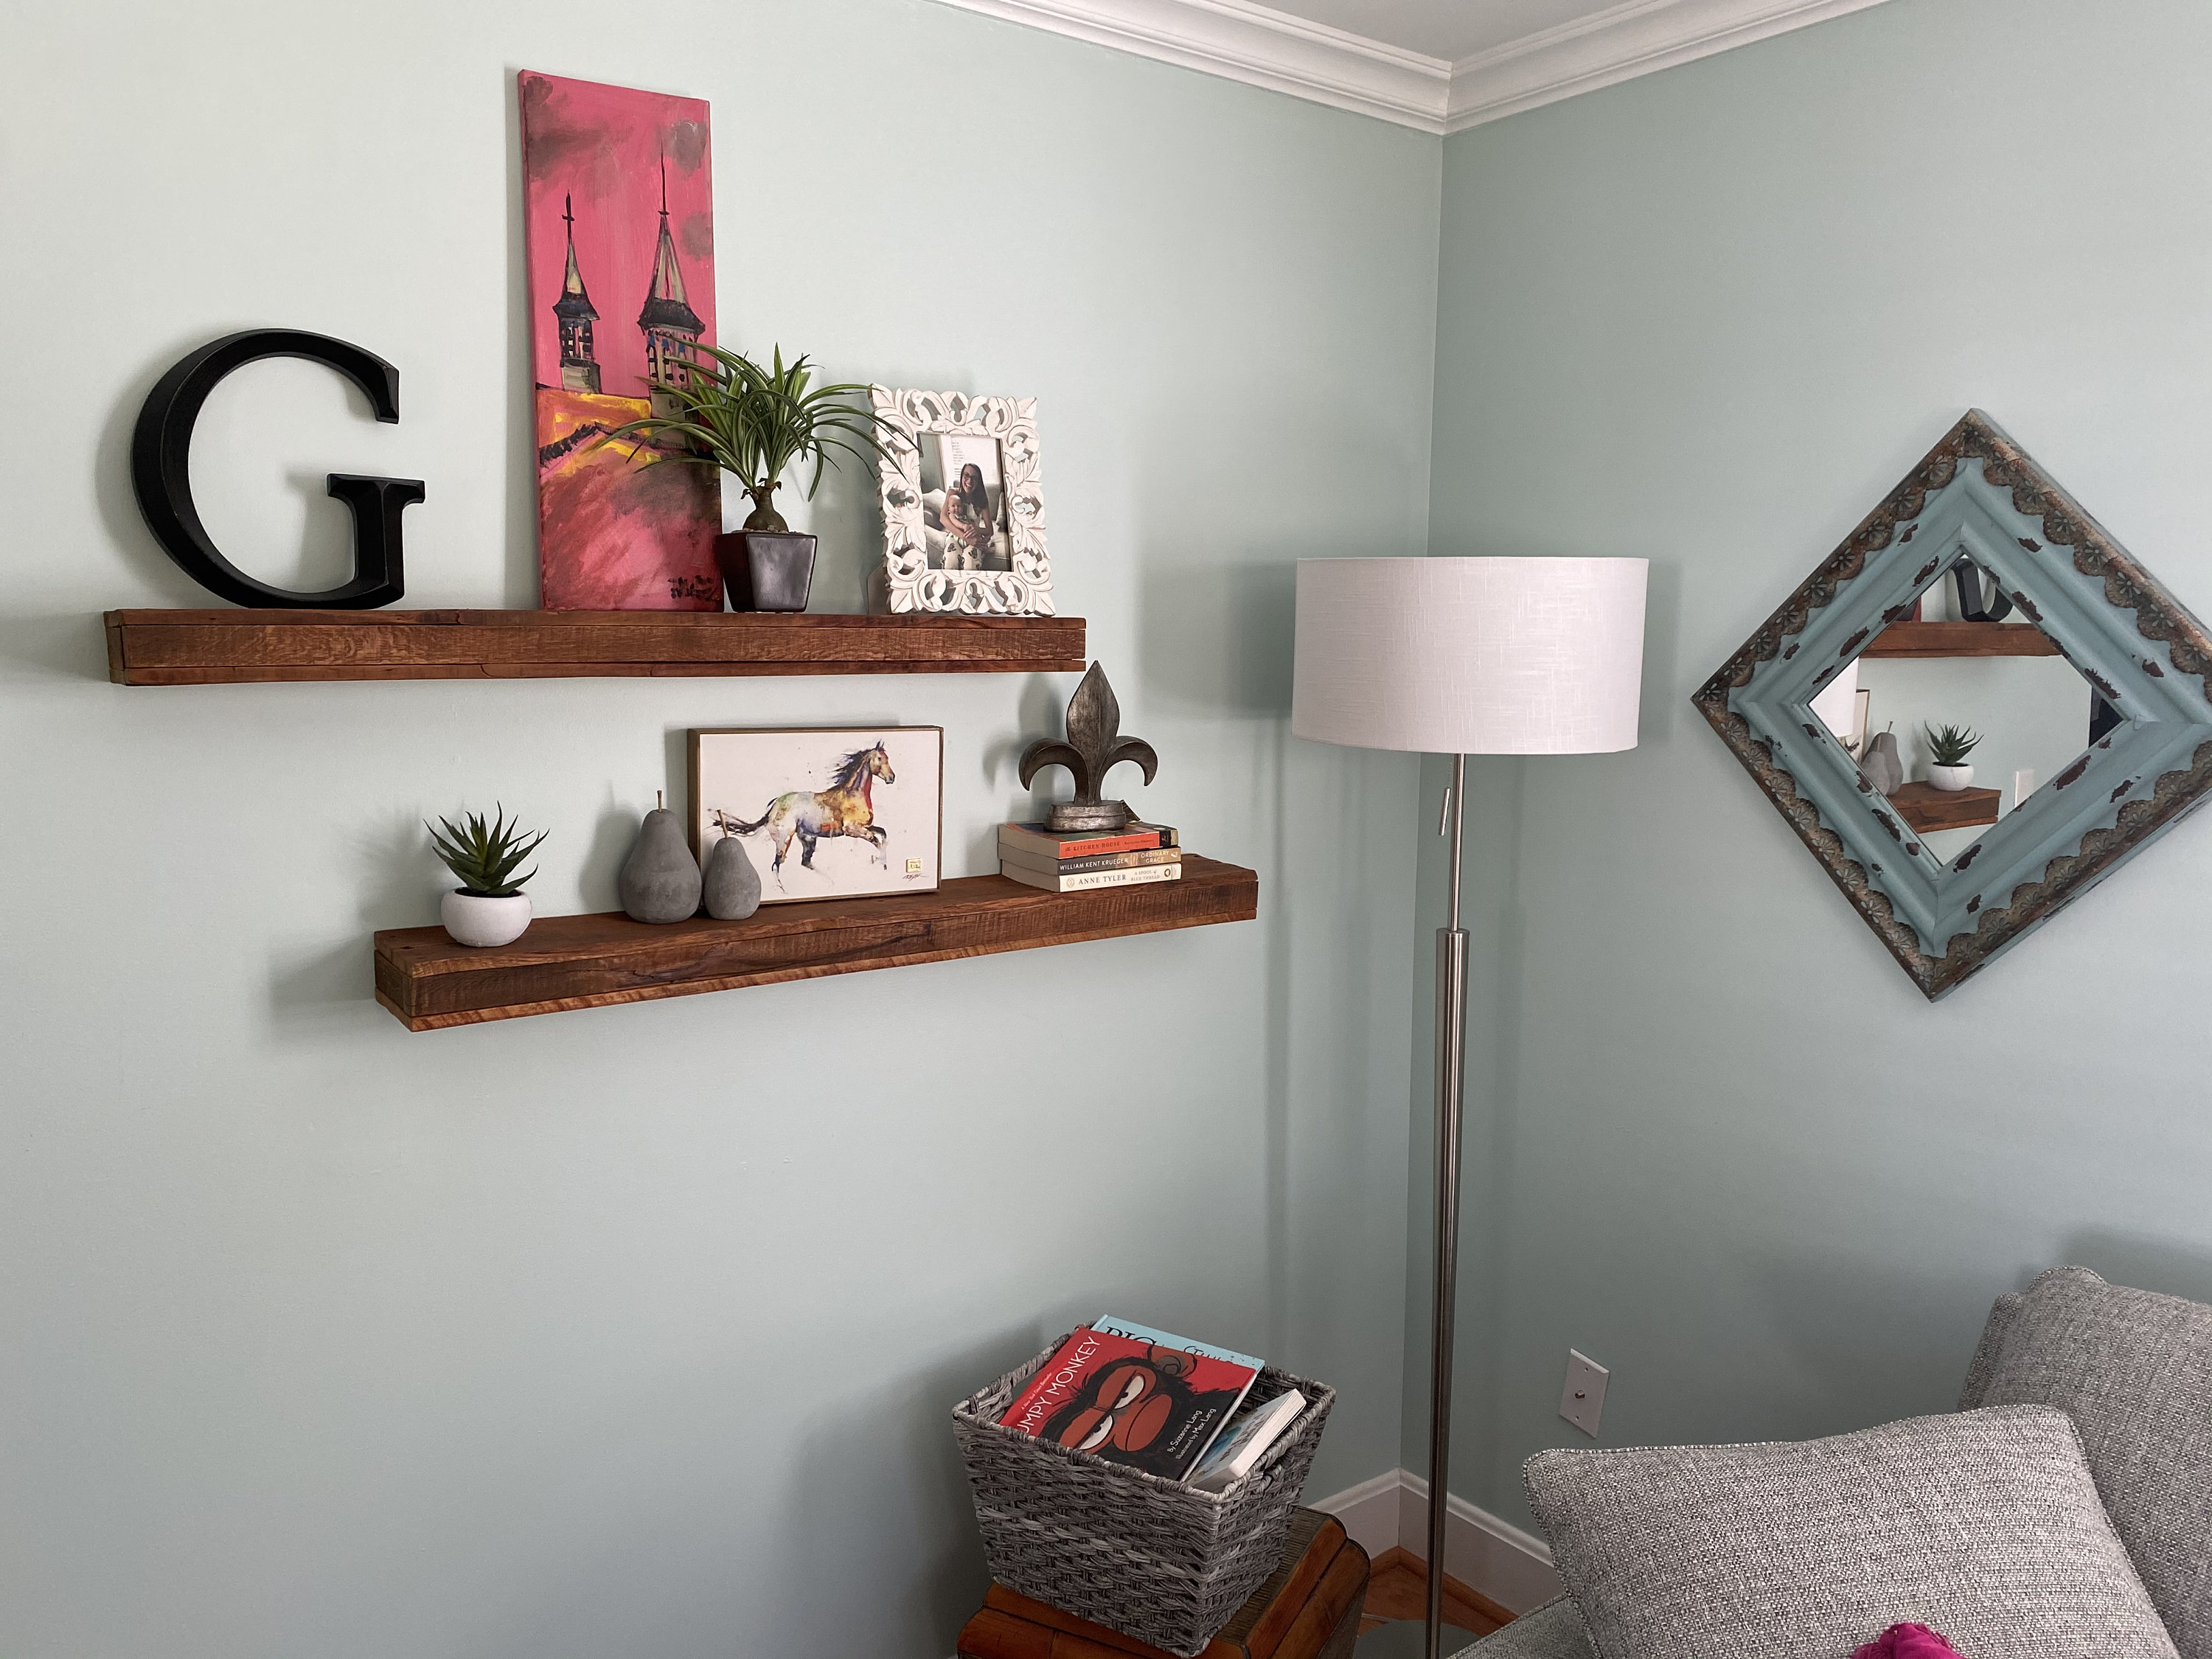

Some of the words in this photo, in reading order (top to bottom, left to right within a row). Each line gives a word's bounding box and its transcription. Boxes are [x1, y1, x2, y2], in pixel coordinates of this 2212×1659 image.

[131, 328, 425, 610] G
[1102, 858, 1128, 866] KRUEGER
[1141, 850, 1169, 858] ORDINARY
[1078, 877, 1100, 885] ANNE
[1103, 874, 1127, 883] TYLER
[1045, 1336, 1100, 1396] MONKEY
[1170, 1424, 1192, 1446] Suzanne
[1186, 1410, 1203, 1424] Lang
[1192, 1422, 1206, 1434] Max
[1200, 1408, 1217, 1422] Lang
